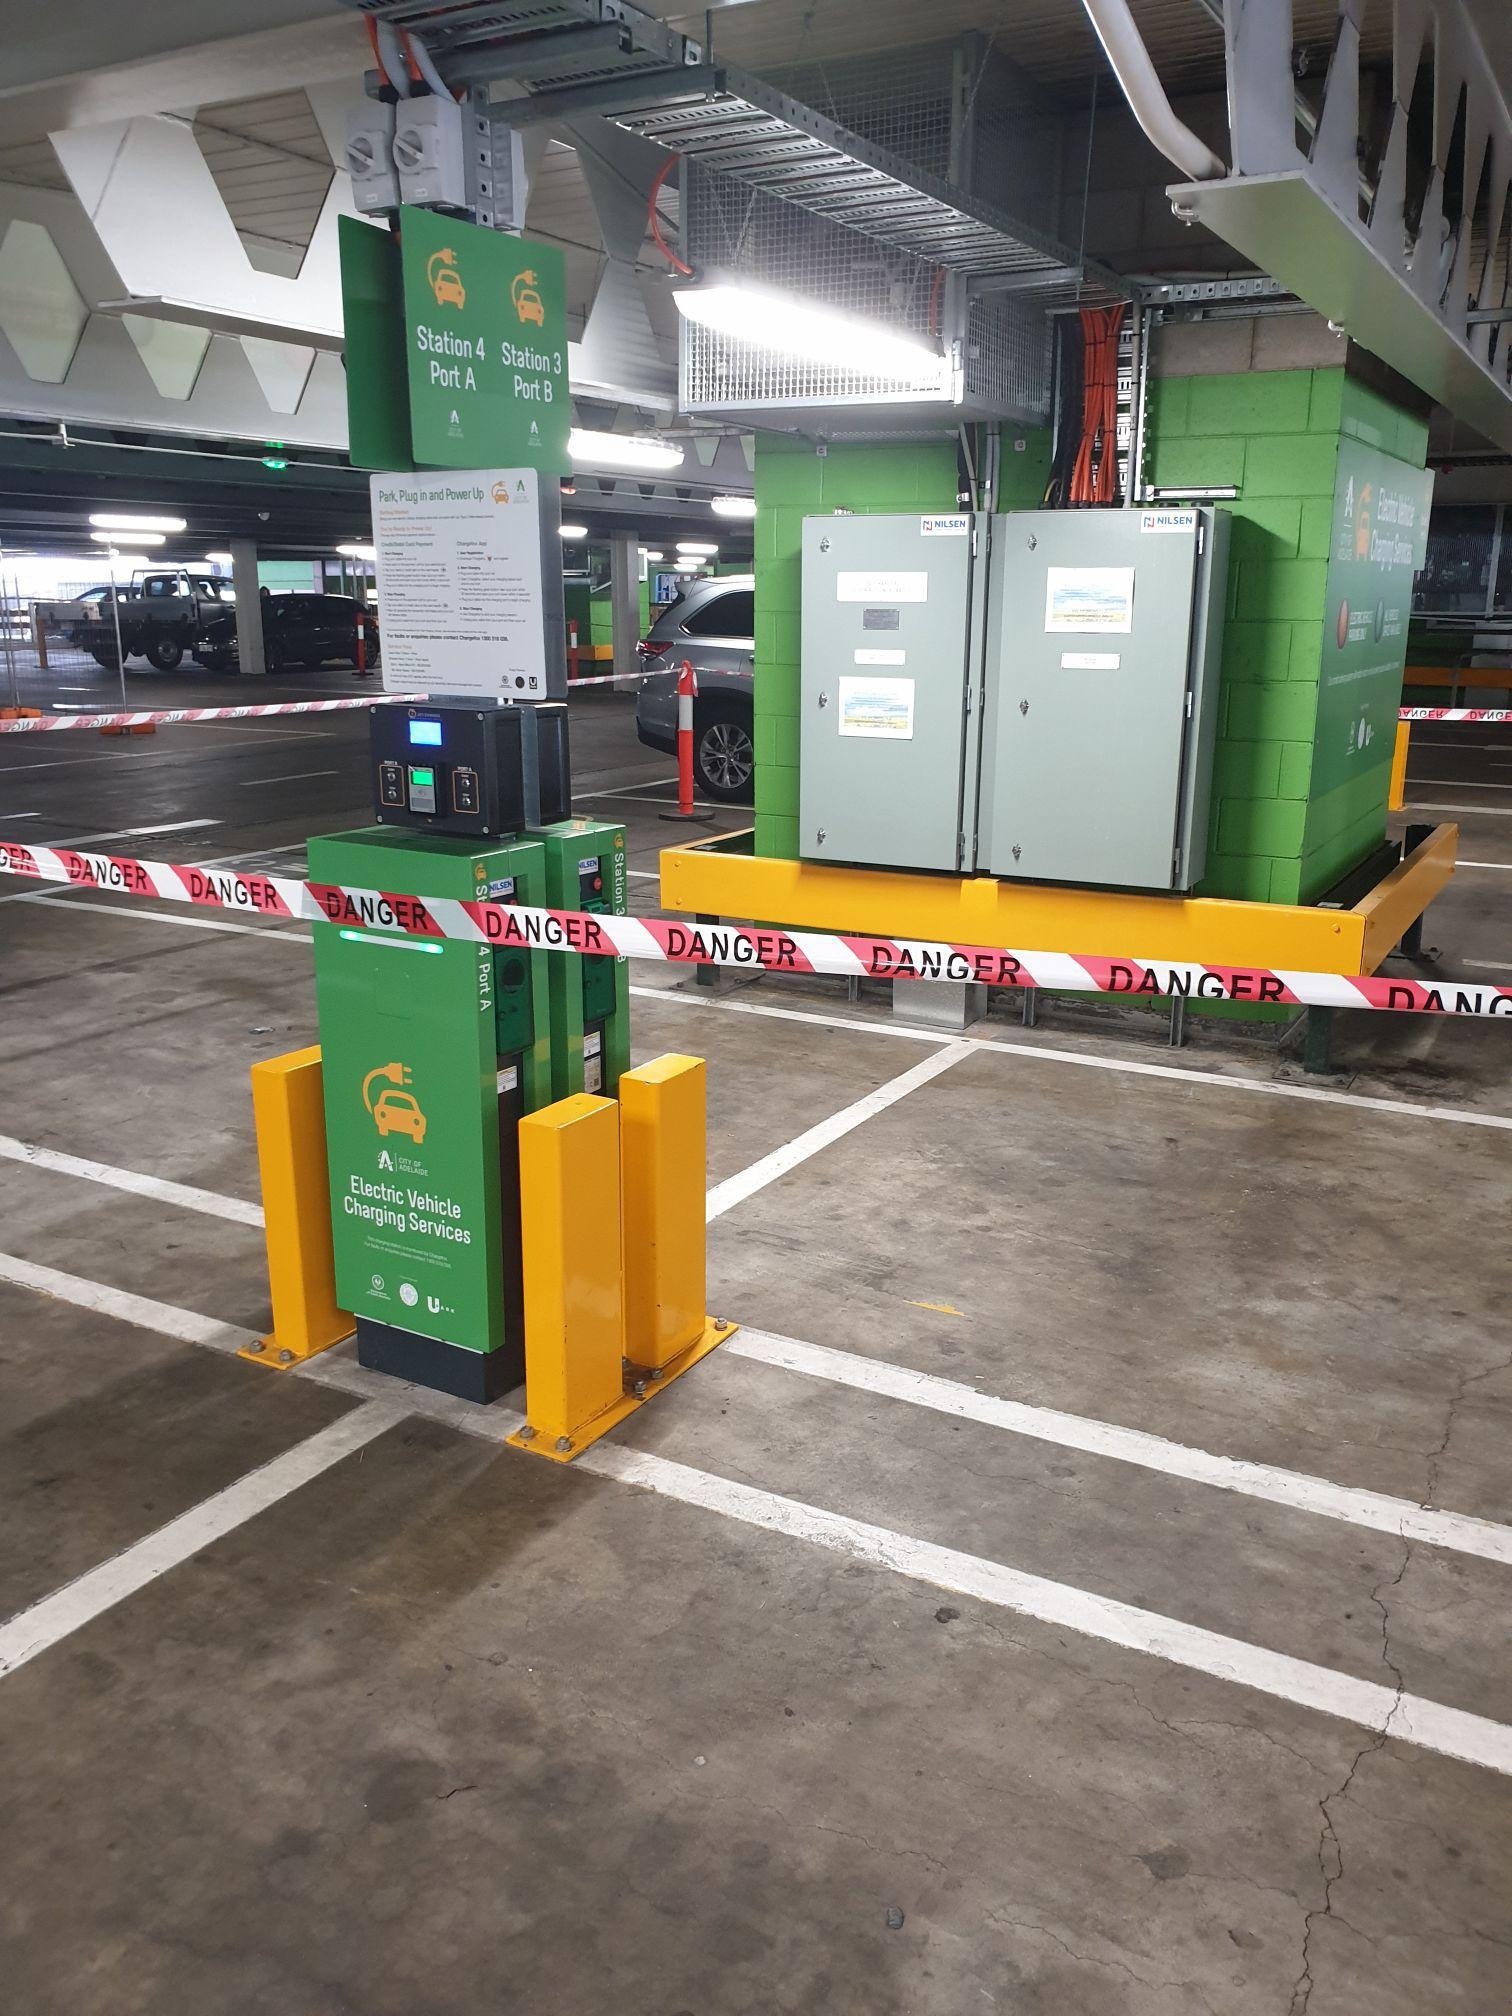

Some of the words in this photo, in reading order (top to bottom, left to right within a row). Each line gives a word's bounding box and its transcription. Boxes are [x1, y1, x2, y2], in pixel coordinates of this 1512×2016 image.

[417, 325, 473, 358] Station
[476, 337, 485, 361] 4
[502, 342, 550, 372] Station
[554, 352, 562, 374] 3
[430, 361, 460, 389] Port
[465, 367, 476, 390] A
[514, 375, 540, 401] Port
[544, 380, 553, 402] B
[379, 490, 398, 503] Park,
[399, 489, 418, 505] Plug
[420, 489, 427, 501] in
[429, 488, 444, 501] and
[446, 487, 471, 500] Power
[473, 487, 484, 503] Up
[934, 520, 966, 528] NILSEN
[1157, 516, 1193, 525] NILSEN
[69, 856, 148, 890] DANGER
[579, 859, 598, 871] NILSEN
[614, 852, 625, 904] Station
[190, 873, 279, 909] DANGER
[489, 880, 513, 892] NILSEN
[326, 892, 429, 930] DANGER
[616, 907, 626, 916] 3
[485, 910, 602, 948] DANGER
[478, 946, 491, 956] 4
[667, 928, 797, 967] DANGER
[479, 963, 491, 995] Port
[871, 945, 1022, 985] DANGER
[1108, 964, 1286, 1002] DANGER
[480, 999, 492, 1011] A
[399, 1165, 429, 1177] ADELAIDE
[350, 1174, 404, 1205] Electric
[407, 1188, 461, 1219] Vehicle
[344, 1195, 406, 1233] Charging
[409, 1212, 471, 1244] Services
